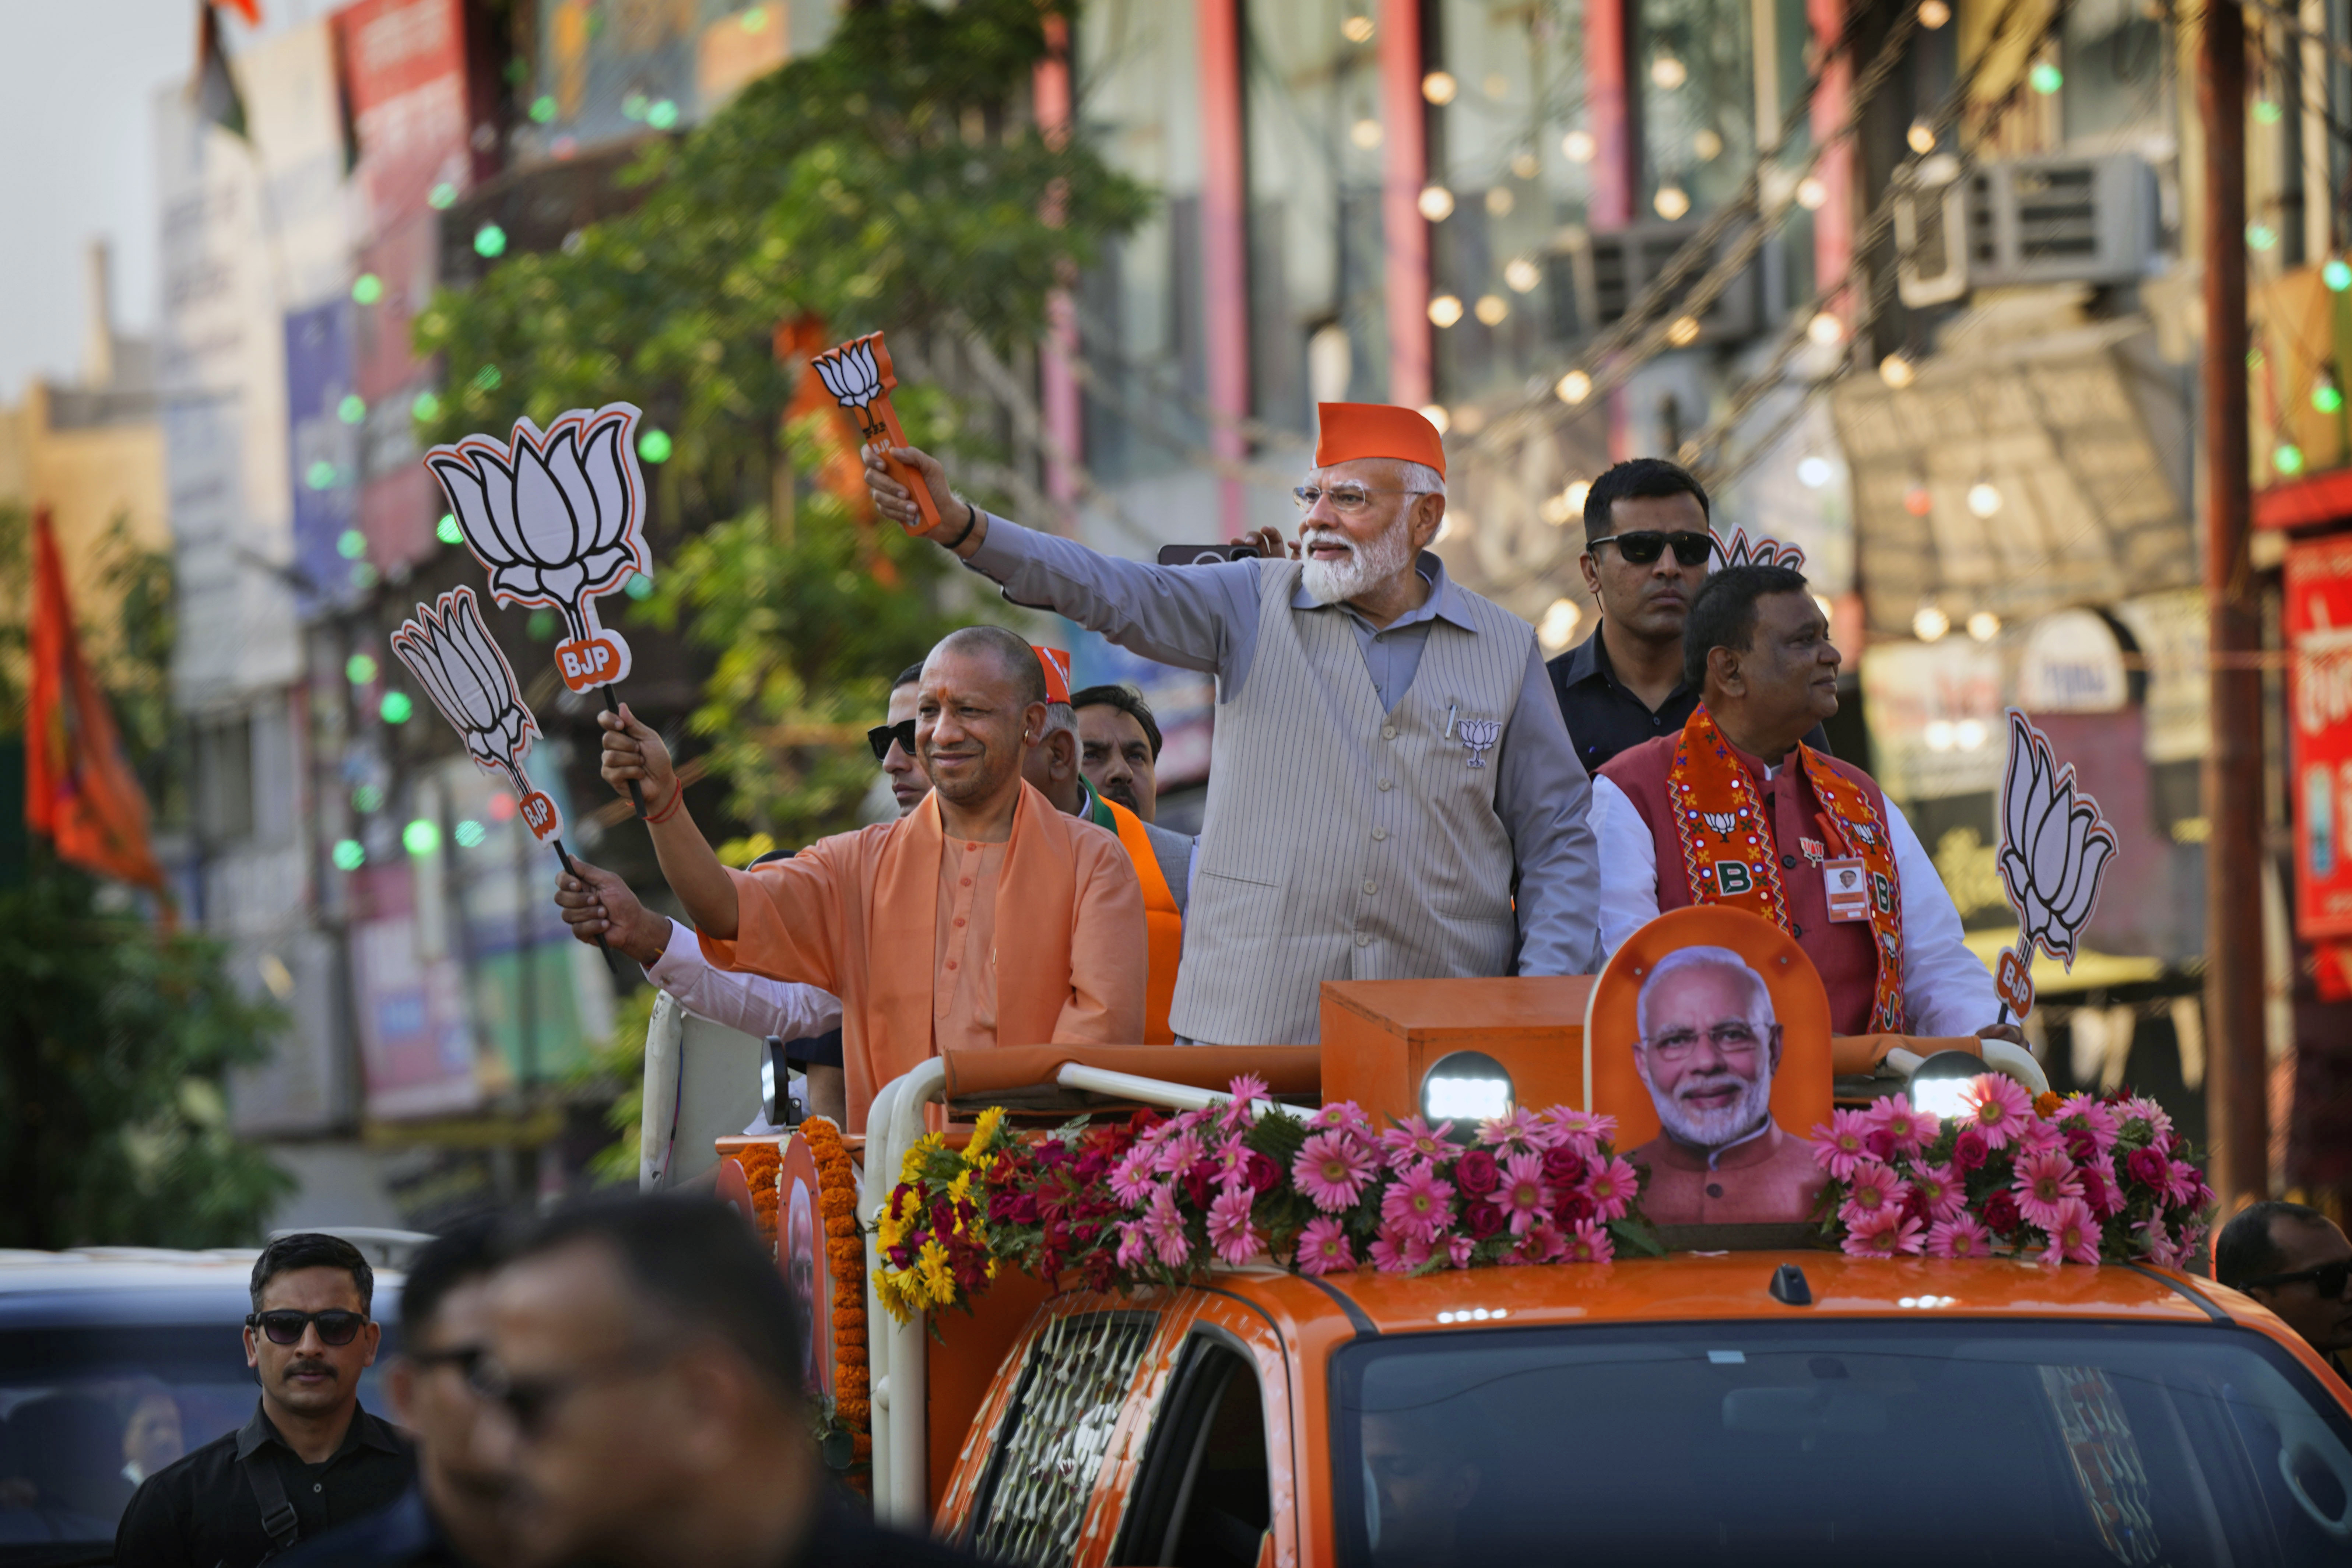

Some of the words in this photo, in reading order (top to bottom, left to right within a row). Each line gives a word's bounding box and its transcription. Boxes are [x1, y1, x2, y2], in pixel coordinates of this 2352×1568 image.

[872, 439, 890, 455] BJP
[562, 646, 610, 678] BJP
[523, 798, 548, 828] BJP
[1715, 860, 1753, 896] B
[1873, 871, 1890, 913] B
[2002, 960, 2029, 1005] BJP
[1884, 991, 1896, 1030] J
